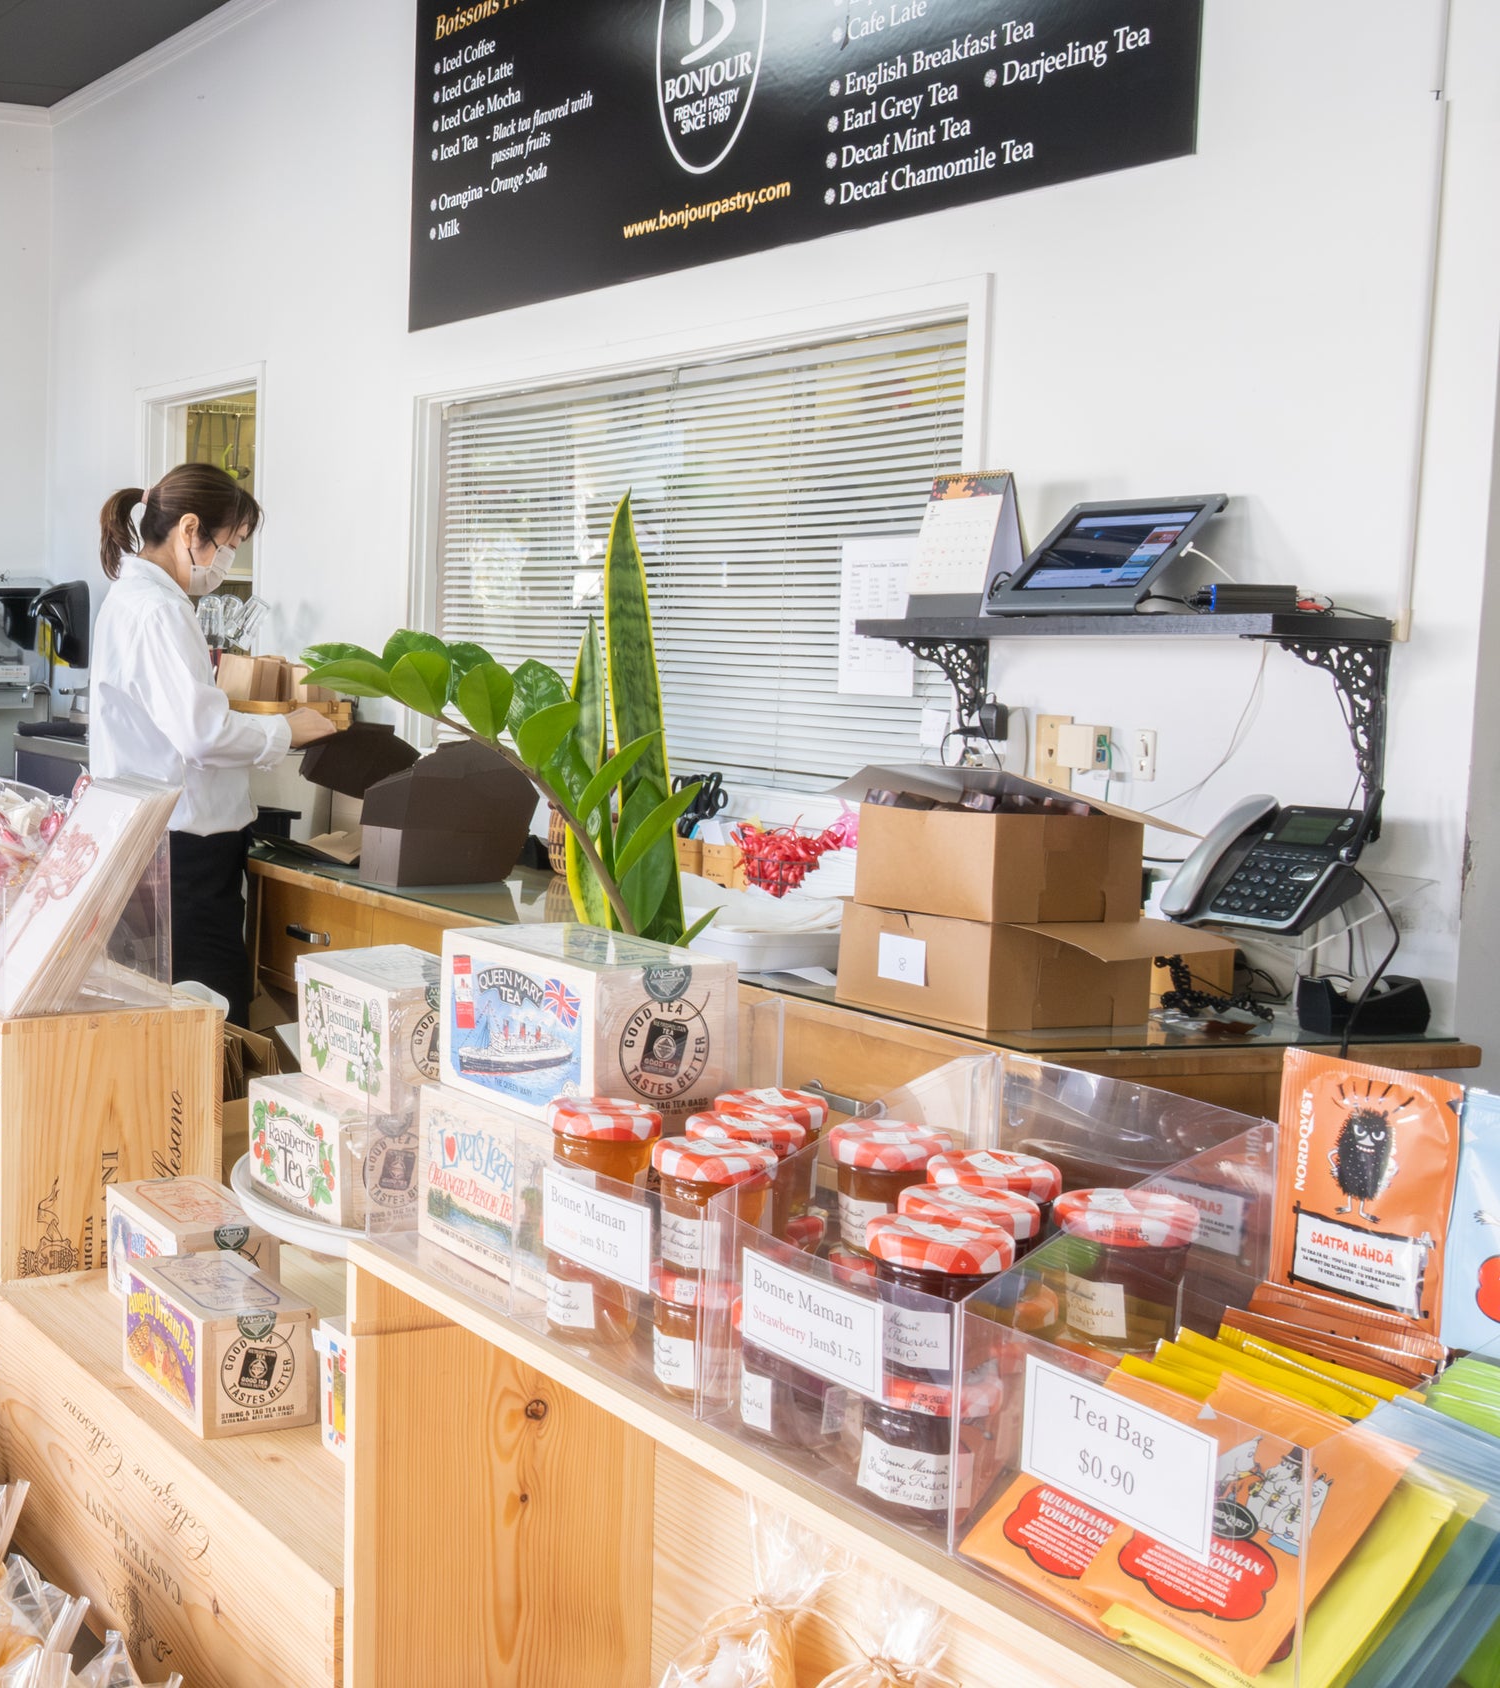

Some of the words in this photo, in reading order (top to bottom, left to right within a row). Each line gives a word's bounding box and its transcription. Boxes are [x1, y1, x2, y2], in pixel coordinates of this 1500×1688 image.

[435, 0, 499, 41] Boissons
[848, 13, 885, 41] Cafe
[890, 1, 927, 27] Late
[442, 53, 462, 74] Iced
[463, 38, 496, 64] Coffee
[664, 51, 753, 104] BONJOUR
[845, 55, 907, 96] English
[912, 29, 998, 76] Breakfast
[1001, 20, 1035, 46] Tea
[1002, 40, 1108, 86] Darjeeling
[1113, 26, 1151, 54] Tea
[441, 81, 461, 103] Iced
[463, 72, 486, 94] Cafe
[488, 61, 514, 84] Latte
[440, 111, 461, 132] Iced
[462, 101, 485, 123] Cafe
[486, 87, 521, 115] Mocha
[440, 139, 460, 161] Iced
[462, 134, 479, 153] Tea
[492, 121, 516, 142] Black
[518, 117, 531, 132] tea
[533, 98, 569, 134] flavored
[570, 89, 594, 113] with
[674, 98, 707, 123] FRENCH
[708, 87, 740, 111] PASTRY
[680, 114, 706, 136] SINCE
[708, 106, 731, 126] 1989
[842, 102, 877, 132] Earl
[880, 94, 924, 120] Grey
[928, 82, 958, 108] Tea
[491, 141, 524, 169] passion
[524, 132, 551, 159] fruits
[841, 134, 890, 168] Decaf
[892, 125, 936, 155] Mint
[940, 117, 971, 142] Tea
[438, 185, 483, 210] Orangina
[491, 172, 524, 195] Orange
[525, 162, 548, 184] Soda
[839, 171, 889, 205] Decaf
[891, 147, 996, 191] Chamomile
[1000, 139, 1034, 165] Tea
[437, 218, 460, 240] Milk
[623, 181, 791, 239] www.bonjourpastry.com
[479, 969, 513, 990] QUEEN
[514, 974, 542, 1001] MARY
[500, 987, 521, 1005] TEA
[325, 1004, 360, 1034] Jasmine
[328, 1025, 348, 1053] Green
[414, 1014, 435, 1045] GOOD
[624, 1008, 652, 1048] GOOD
[658, 1002, 683, 1016] TEA
[628, 1065, 673, 1095] TASTES
[677, 1036, 706, 1088] BETTER
[268, 1121, 315, 1163] Raspberry
[1294, 1089, 1315, 1191] NORDQVIST
[278, 1145, 305, 1192] Tea
[428, 1161, 467, 1197] ORANGE
[551, 1185, 582, 1214] Bonne
[584, 1199, 626, 1232] Maman
[579, 1230, 594, 1247] jam
[596, 1234, 619, 1258] $1.75
[1310, 1231, 1349, 1254] SAATPA
[1352, 1242, 1393, 1266] NÄHDÄ
[753, 1269, 794, 1305] Bonne
[798, 1289, 854, 1330] Maman
[752, 1305, 806, 1344] Strawberry
[225, 1340, 247, 1370] GOOD
[228, 1382, 266, 1404] TASTES
[268, 1358, 292, 1398] BETTER
[1070, 1394, 1108, 1433] Tea
[1115, 1414, 1155, 1460] Bag
[1078, 1448, 1135, 1495] $0.90
[1038, 1503, 1108, 1545] VOIMAJUOM
[85, 1491, 182, 1606] CASTELLANI
